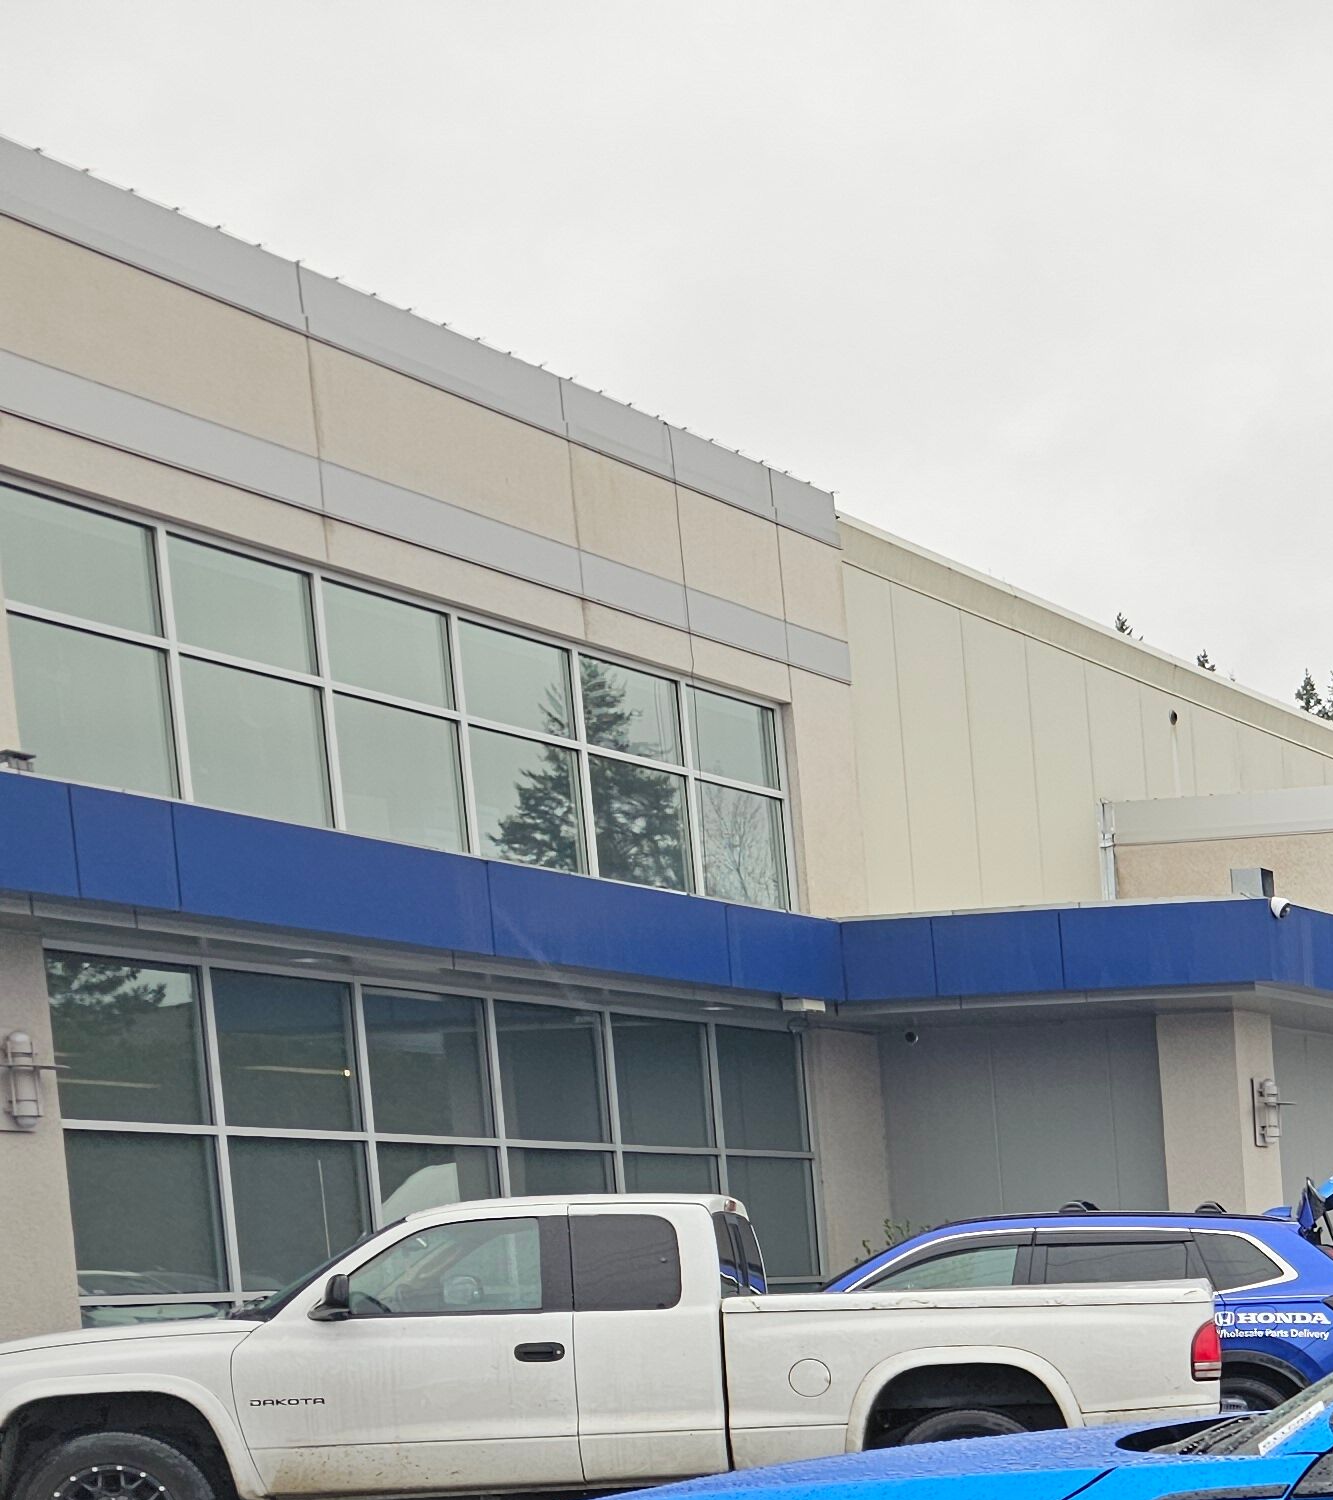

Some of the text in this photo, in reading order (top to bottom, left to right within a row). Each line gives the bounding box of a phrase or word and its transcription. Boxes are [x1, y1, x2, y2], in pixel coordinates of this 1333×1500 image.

[1237, 1312, 1331, 1325] HONDA
[1265, 1328, 1289, 1338] Parts
[1290, 1328, 1330, 1341] Delivery
[249, 1397, 326, 1407] DAKOTA
